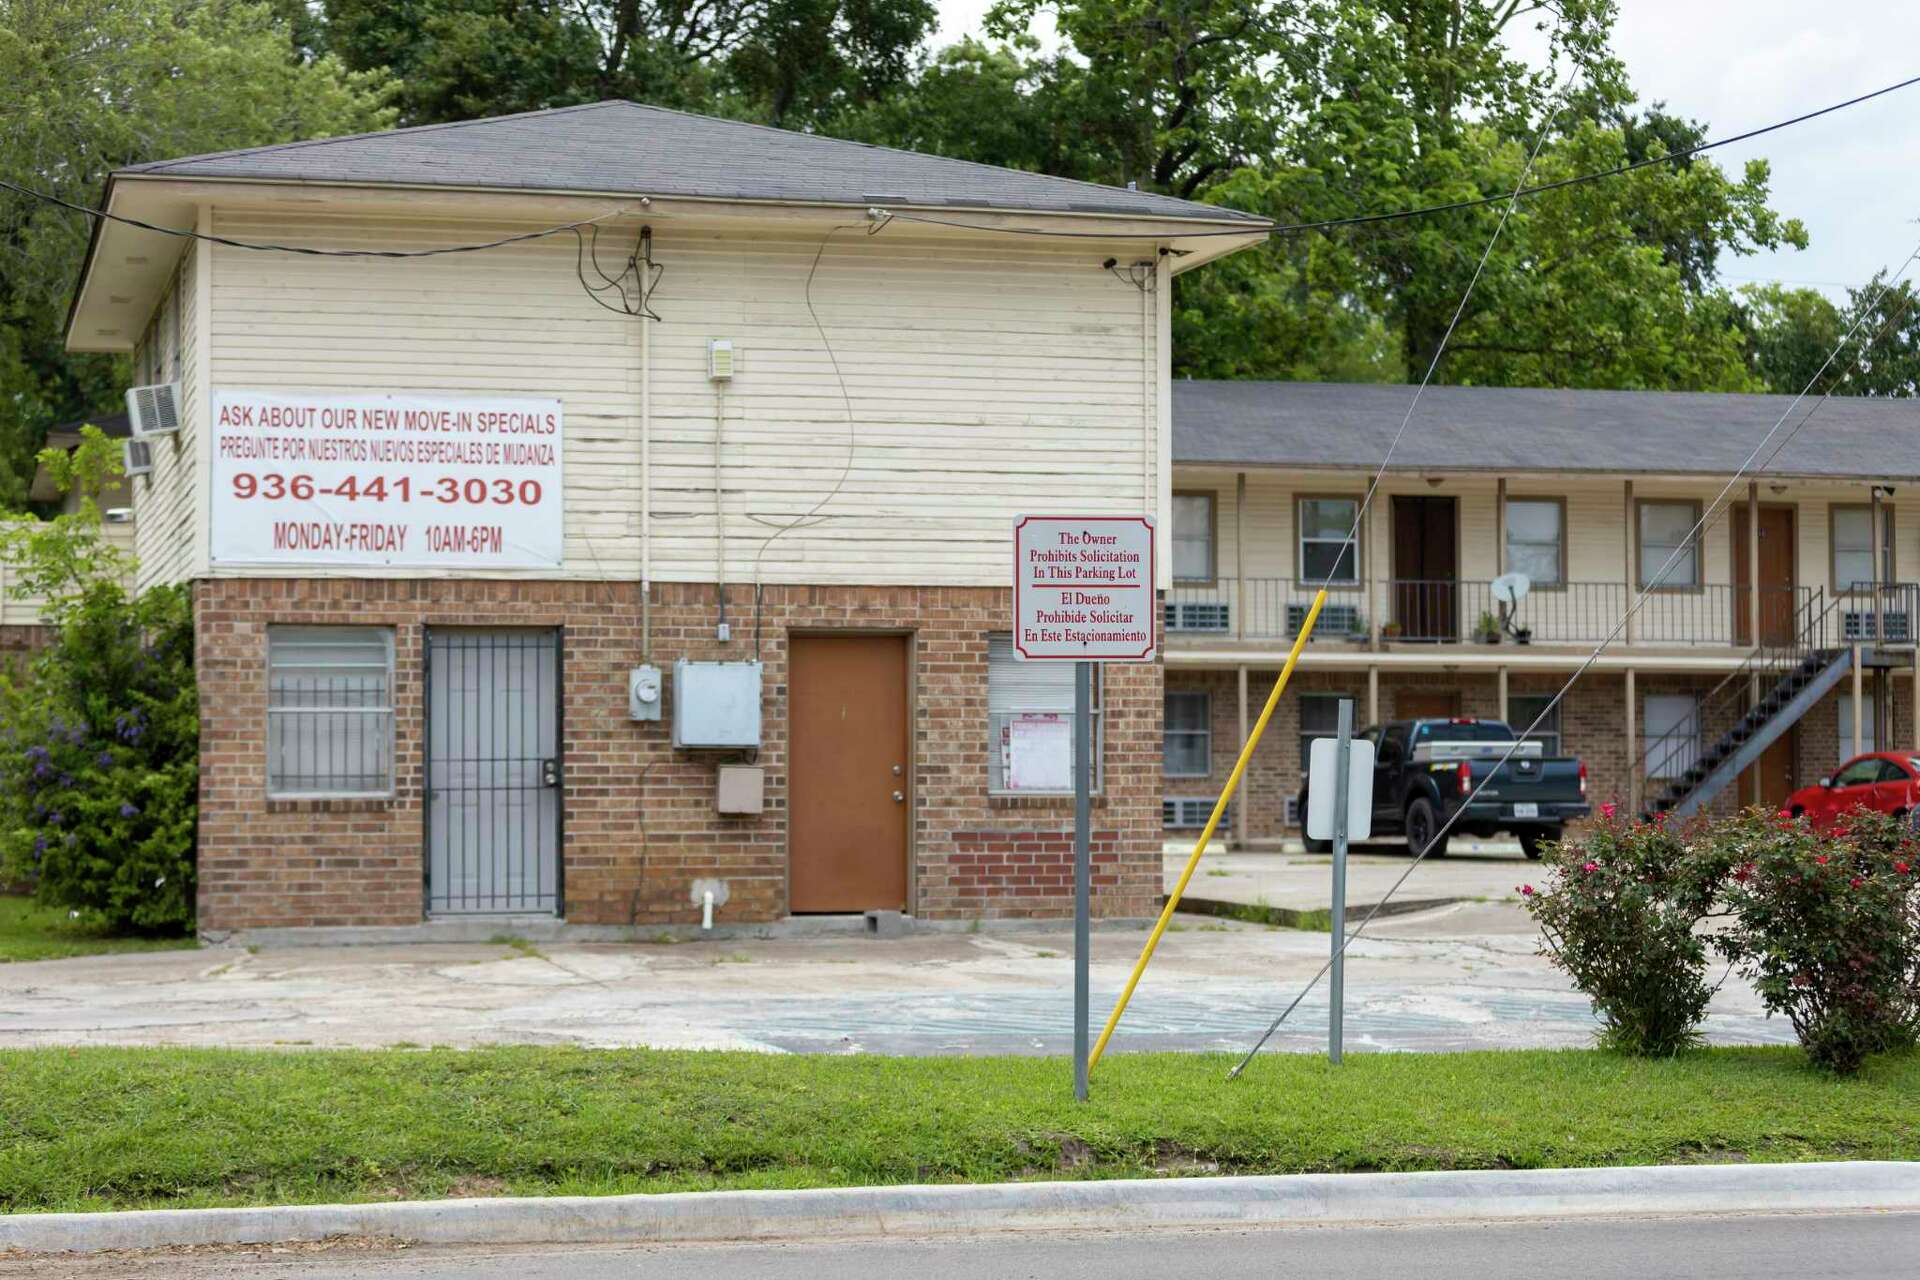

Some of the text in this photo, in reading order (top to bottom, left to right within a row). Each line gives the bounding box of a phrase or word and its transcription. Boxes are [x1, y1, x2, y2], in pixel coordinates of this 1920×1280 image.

[219, 405, 556, 435] ASK ABOUT OUR NEW MOVE-IN SPECIALS
[220, 436, 556, 466] PREGUNTE POR NUESTROS NUEVOS ESPECIALES DE MUDANZA
[232, 472, 543, 506] 936-441-3030
[273, 521, 503, 553] MONDAY-FRIDAY 10AM-6PM
[1059, 532, 1117, 545] The Owner
[1030, 549, 1140, 563] Prohibits Solicitation
[1034, 566, 1136, 581] In This Parking Lot
[1061, 592, 1073, 605] El
[1036, 610, 1134, 623] Prohibide Solicitar
[1025, 628, 1147, 642] En Este Estacionamiento
